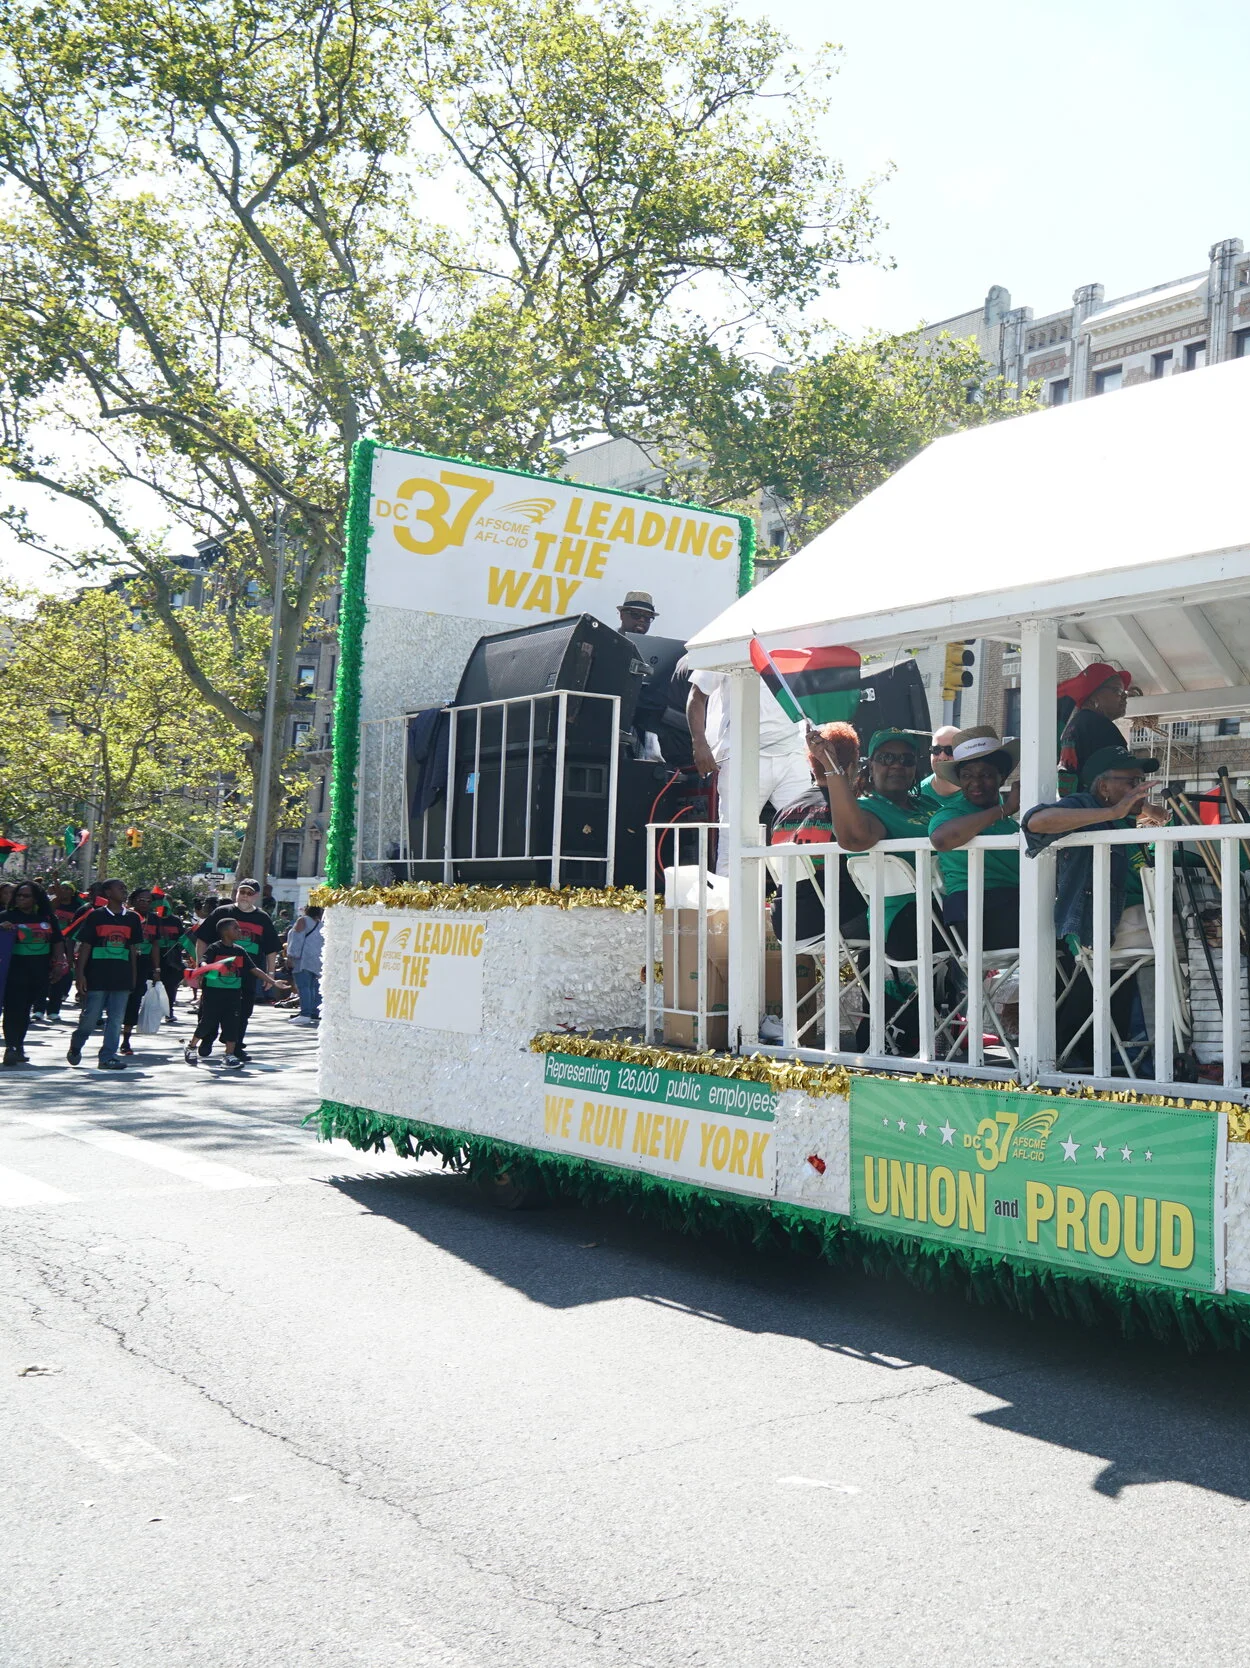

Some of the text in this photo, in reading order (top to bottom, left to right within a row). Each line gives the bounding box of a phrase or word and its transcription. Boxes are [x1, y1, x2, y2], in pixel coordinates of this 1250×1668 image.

[376, 470, 494, 555] DC 37
[475, 517, 531, 535] AFSCME
[563, 497, 734, 561] LEADING
[474, 531, 528, 549] AFL-CIO
[531, 532, 611, 579] THE
[487, 566, 582, 615] WAY
[353, 921, 390, 986] DC 37
[414, 923, 485, 957] LEADING
[401, 955, 430, 988] THE
[386, 988, 419, 1021] WAY
[546, 1056, 778, 1116] Representing 126,000 public employees
[544, 1095, 772, 1179] WE RUN NEW YORK
[963, 1111, 1019, 1171] DC 37
[1012, 1136, 1046, 1150] AFSCME
[1012, 1149, 1045, 1162] AFL-CIO
[863, 1155, 1195, 1270] UNION and PROUD
